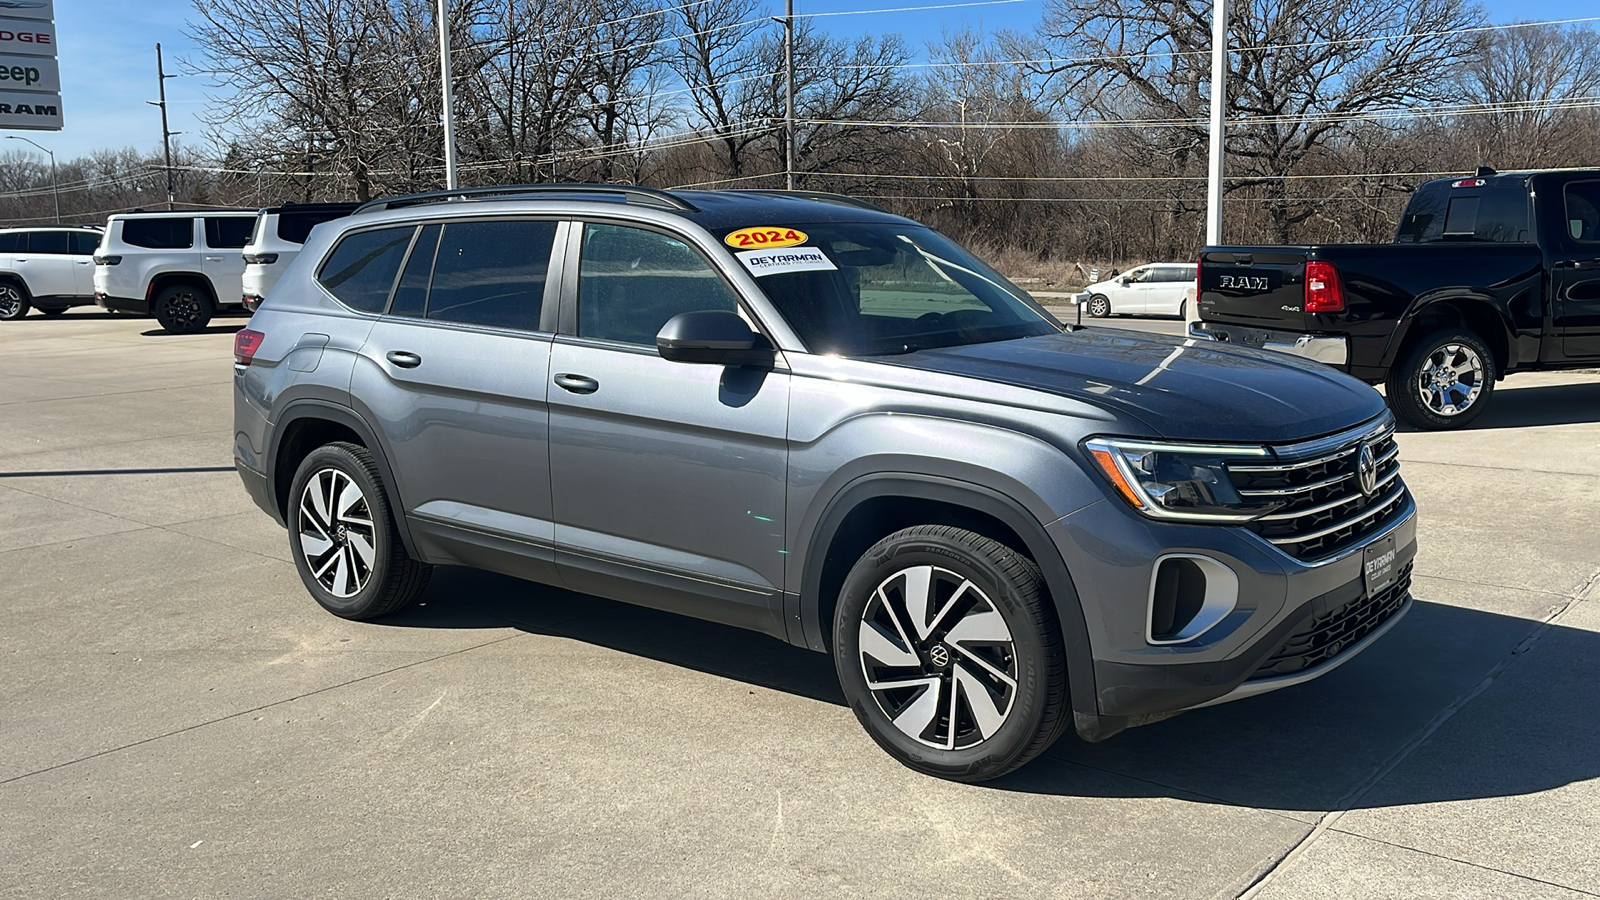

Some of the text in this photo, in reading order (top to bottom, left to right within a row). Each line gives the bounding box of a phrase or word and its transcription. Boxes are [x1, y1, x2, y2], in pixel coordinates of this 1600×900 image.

[0, 103, 57, 116] RAM
[735, 230, 800, 246] 2024
[749, 253, 823, 266] DEYARMAN
[1219, 275, 1268, 290] RAM
[1366, 548, 1396, 575] DEYARMAN
